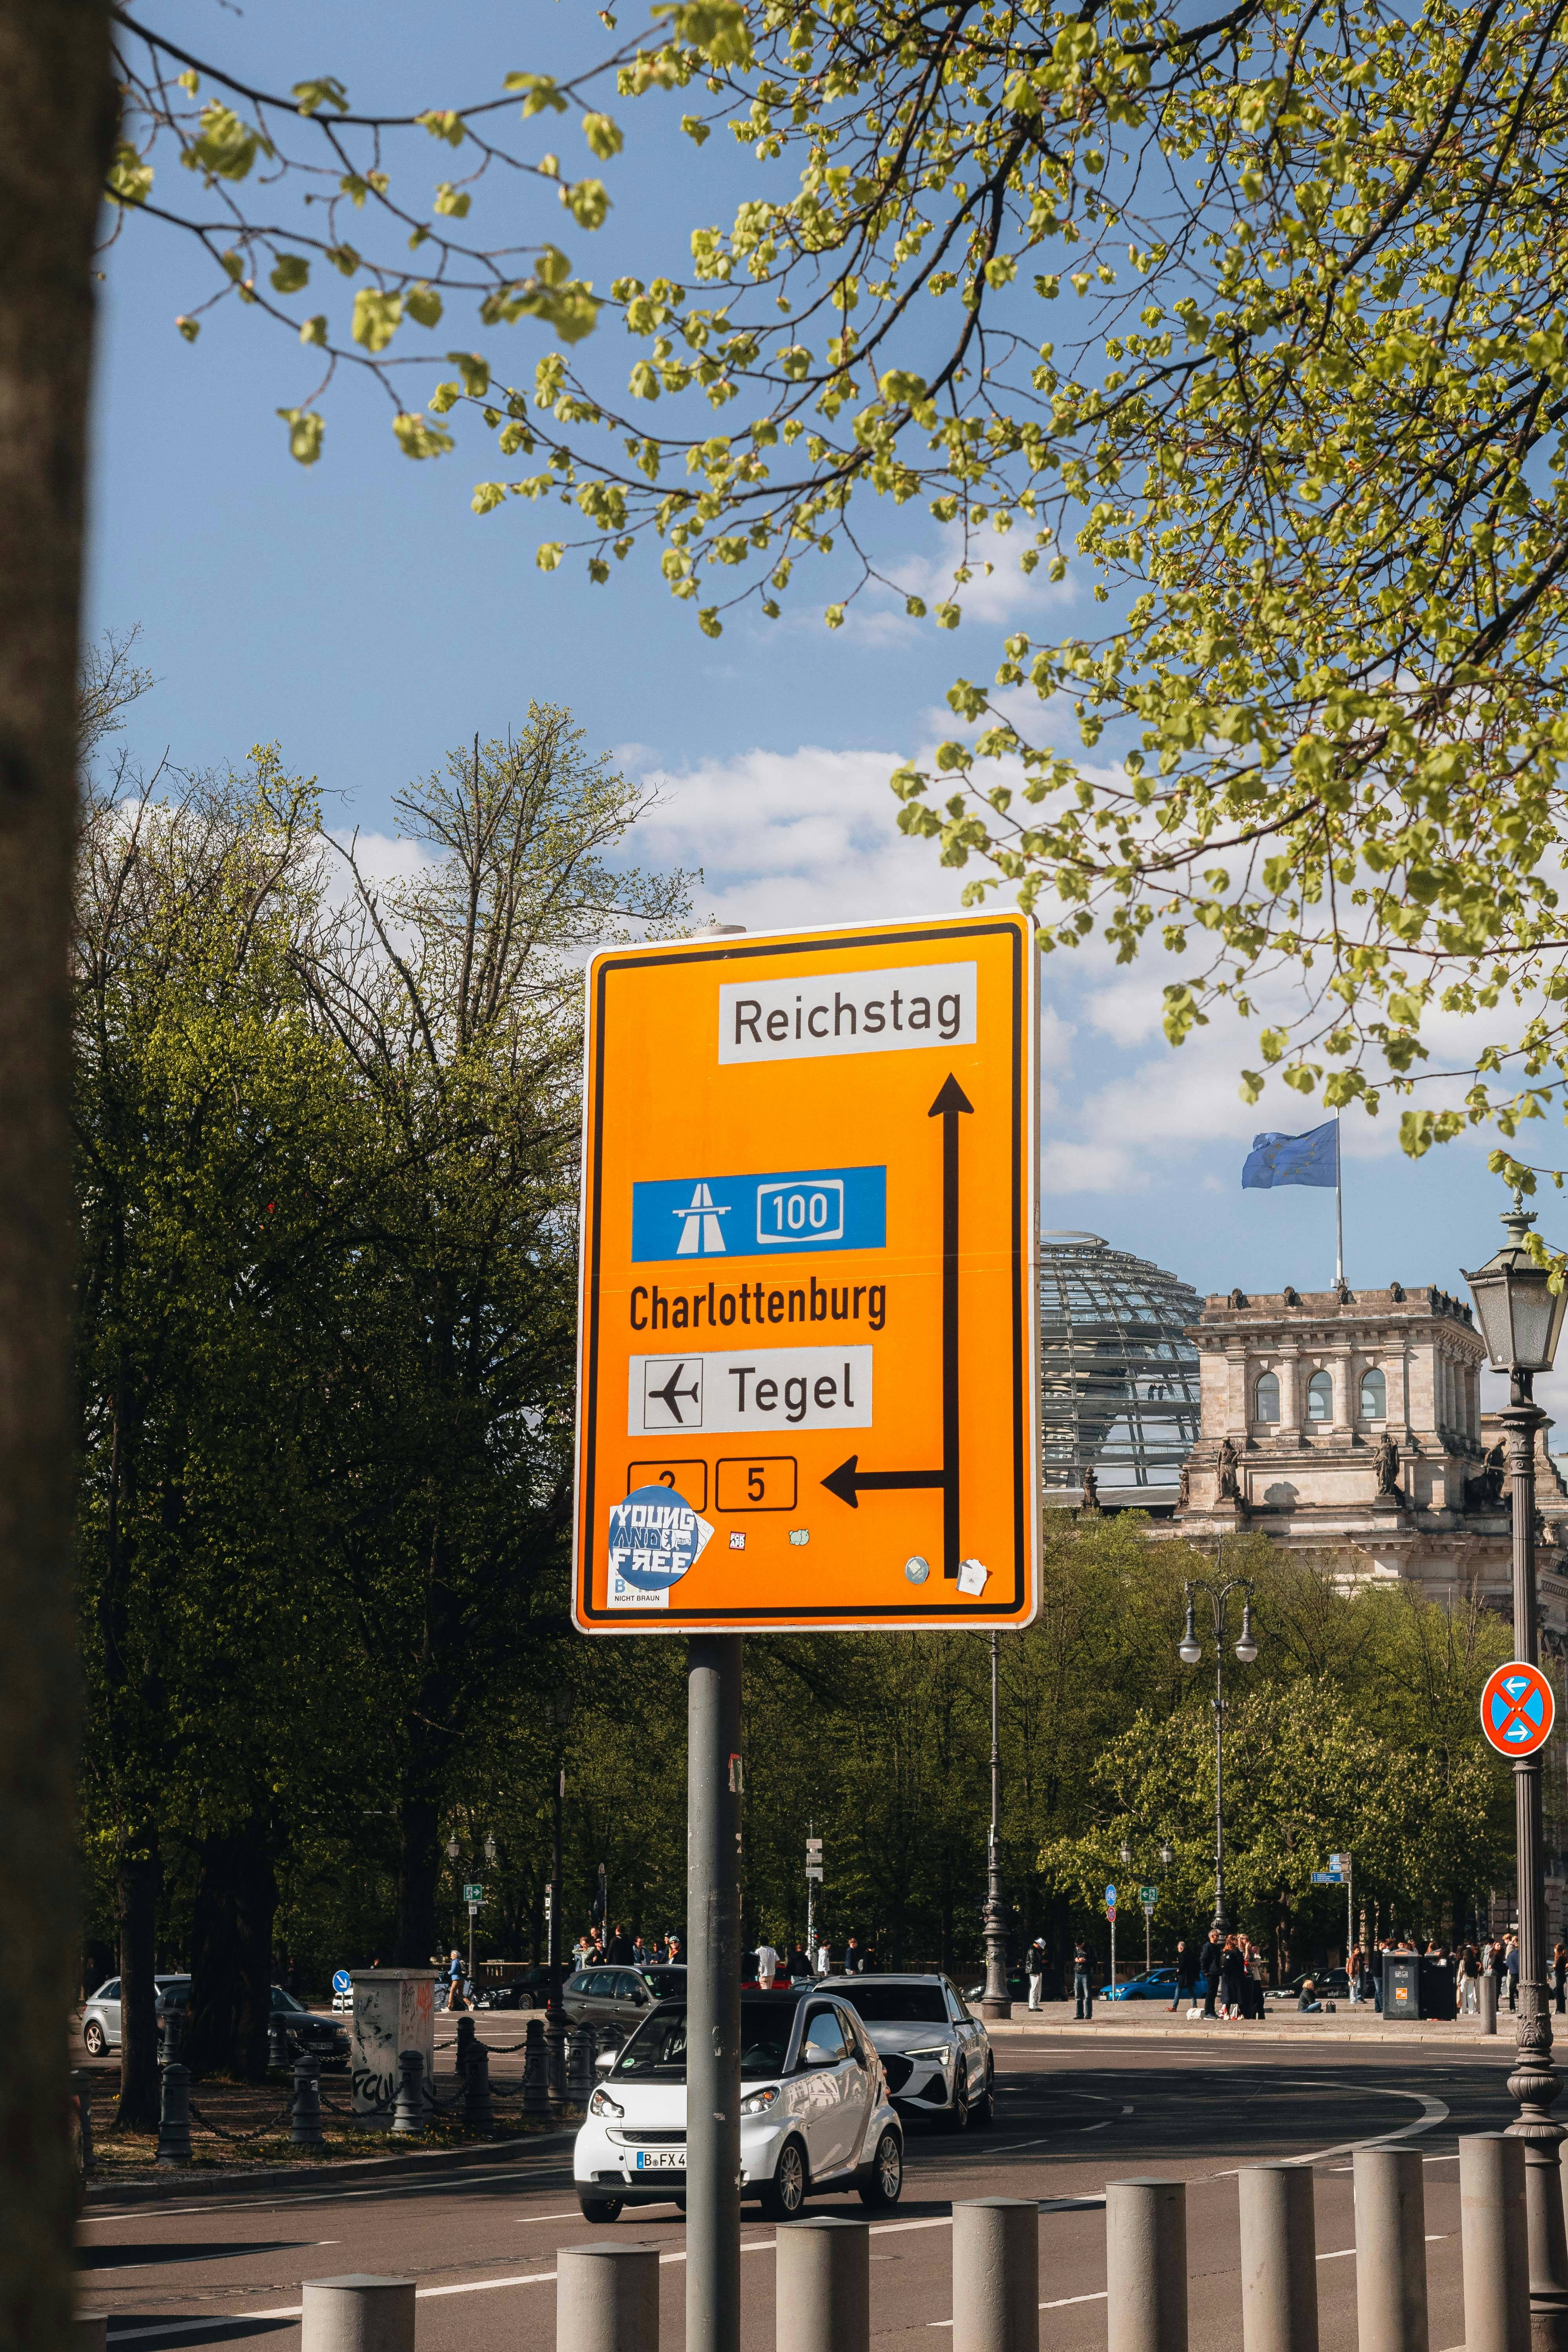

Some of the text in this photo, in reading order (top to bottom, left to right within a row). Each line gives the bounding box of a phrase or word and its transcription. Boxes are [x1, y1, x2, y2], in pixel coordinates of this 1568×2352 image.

[735, 990, 960, 1044] Reichstag
[774, 1193, 828, 1230] 100
[630, 1276, 886, 1331] Charlottenburg
[729, 1363, 855, 1423] Tegel
[747, 1467, 765, 1501] 5
[617, 1504, 695, 1531] YOUNG
[613, 1526, 662, 1550] AND
[613, 1548, 691, 1574] FREE
[644, 2154, 652, 2166] B
[660, 2154, 675, 2166] FX
